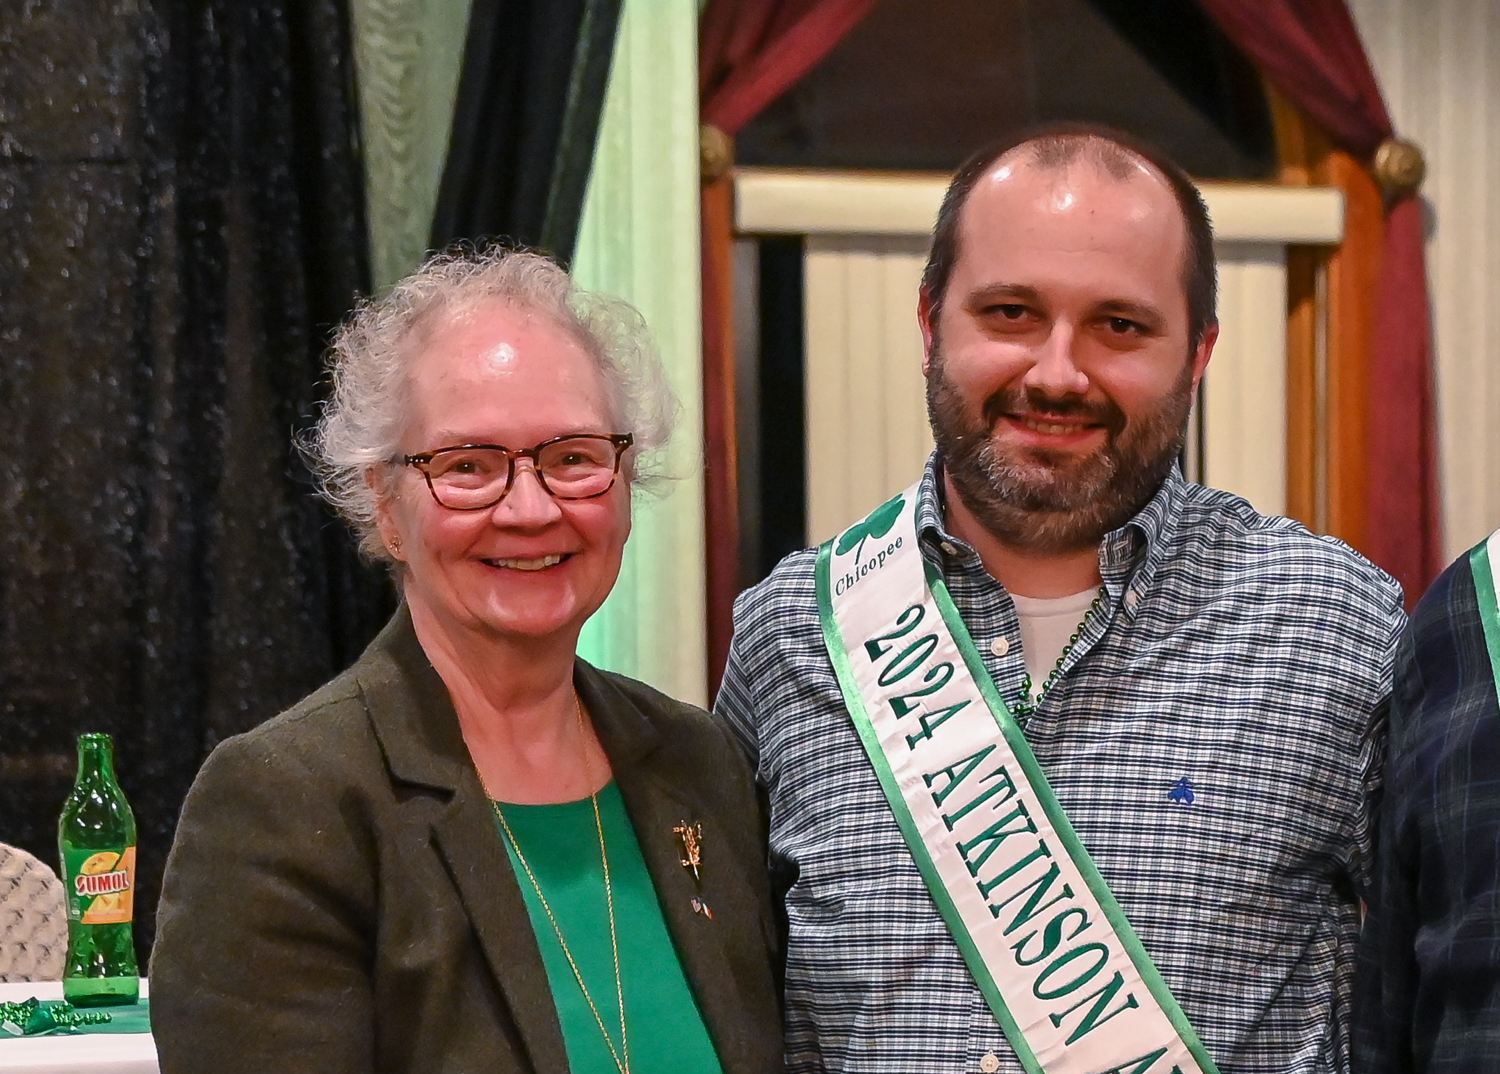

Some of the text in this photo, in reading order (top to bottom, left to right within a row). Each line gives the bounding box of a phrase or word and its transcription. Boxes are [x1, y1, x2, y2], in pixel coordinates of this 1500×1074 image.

[835, 535, 904, 598] Chicopee
[865, 604, 972, 750] 2024
[921, 743, 1140, 1047] ATKINSON
[75, 870, 129, 896] SUMOL
